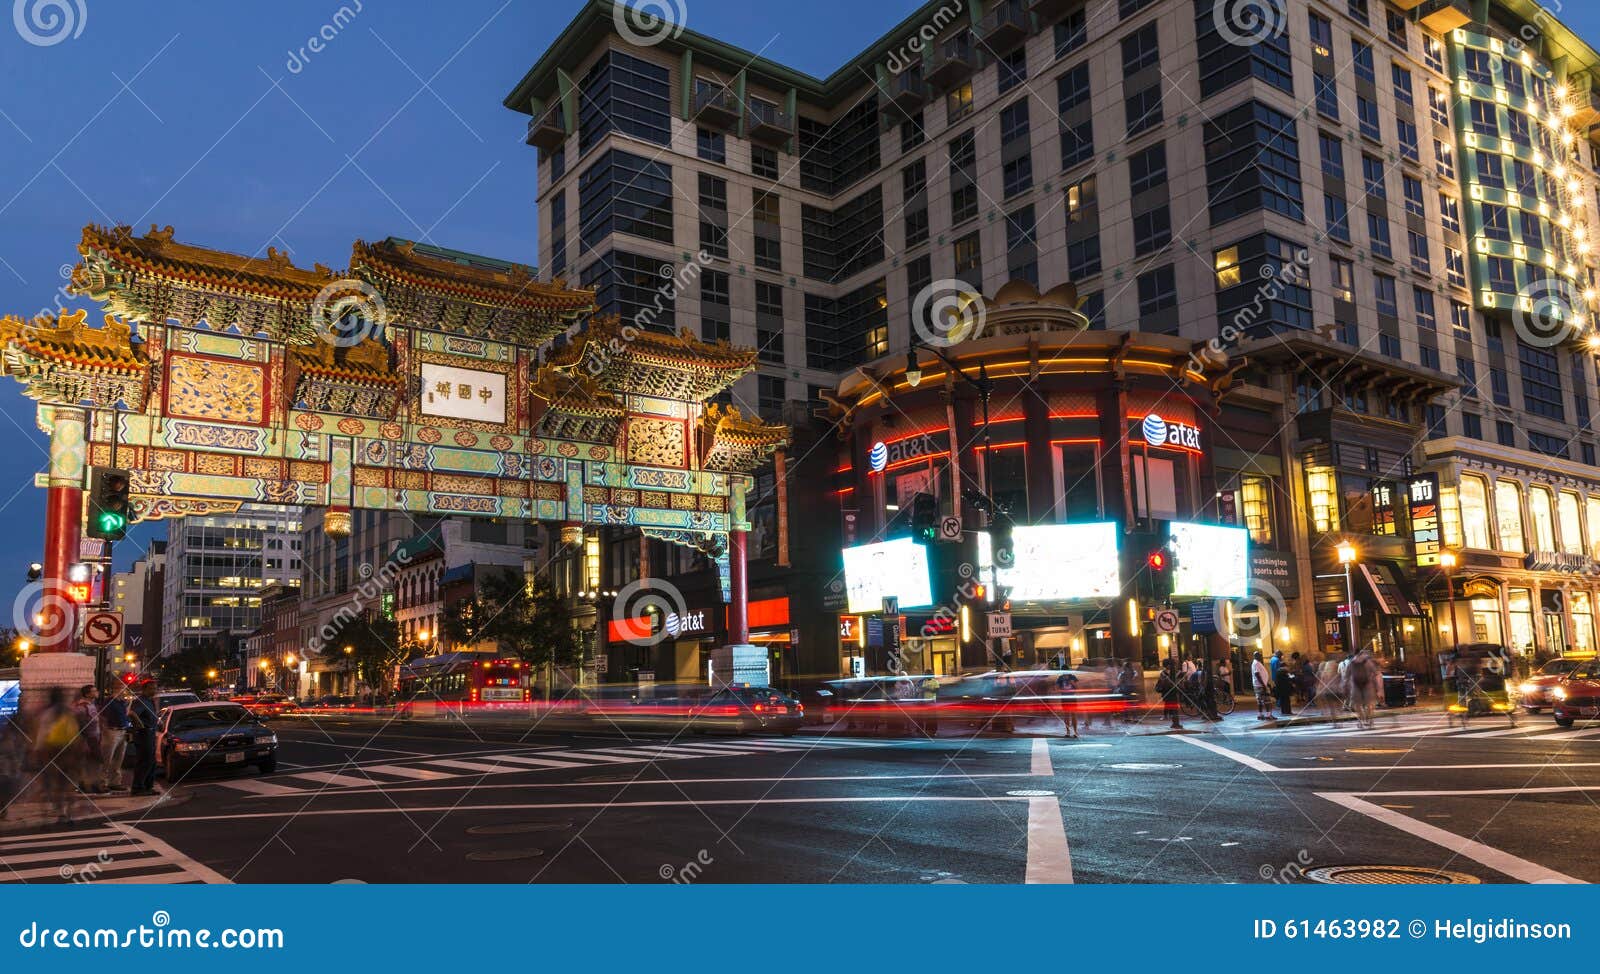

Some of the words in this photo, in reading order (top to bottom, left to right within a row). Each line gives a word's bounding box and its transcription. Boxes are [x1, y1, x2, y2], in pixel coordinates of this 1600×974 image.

[1170, 422, 1200, 450] at&t
[891, 434, 931, 462] at&t
[1411, 480, 1432, 501] 前
[1253, 558, 1287, 566] washington
[1254, 567, 1272, 575] sports
[1273, 568, 1288, 576] clubs
[884, 599, 897, 614] M
[681, 611, 704, 631] at&t
